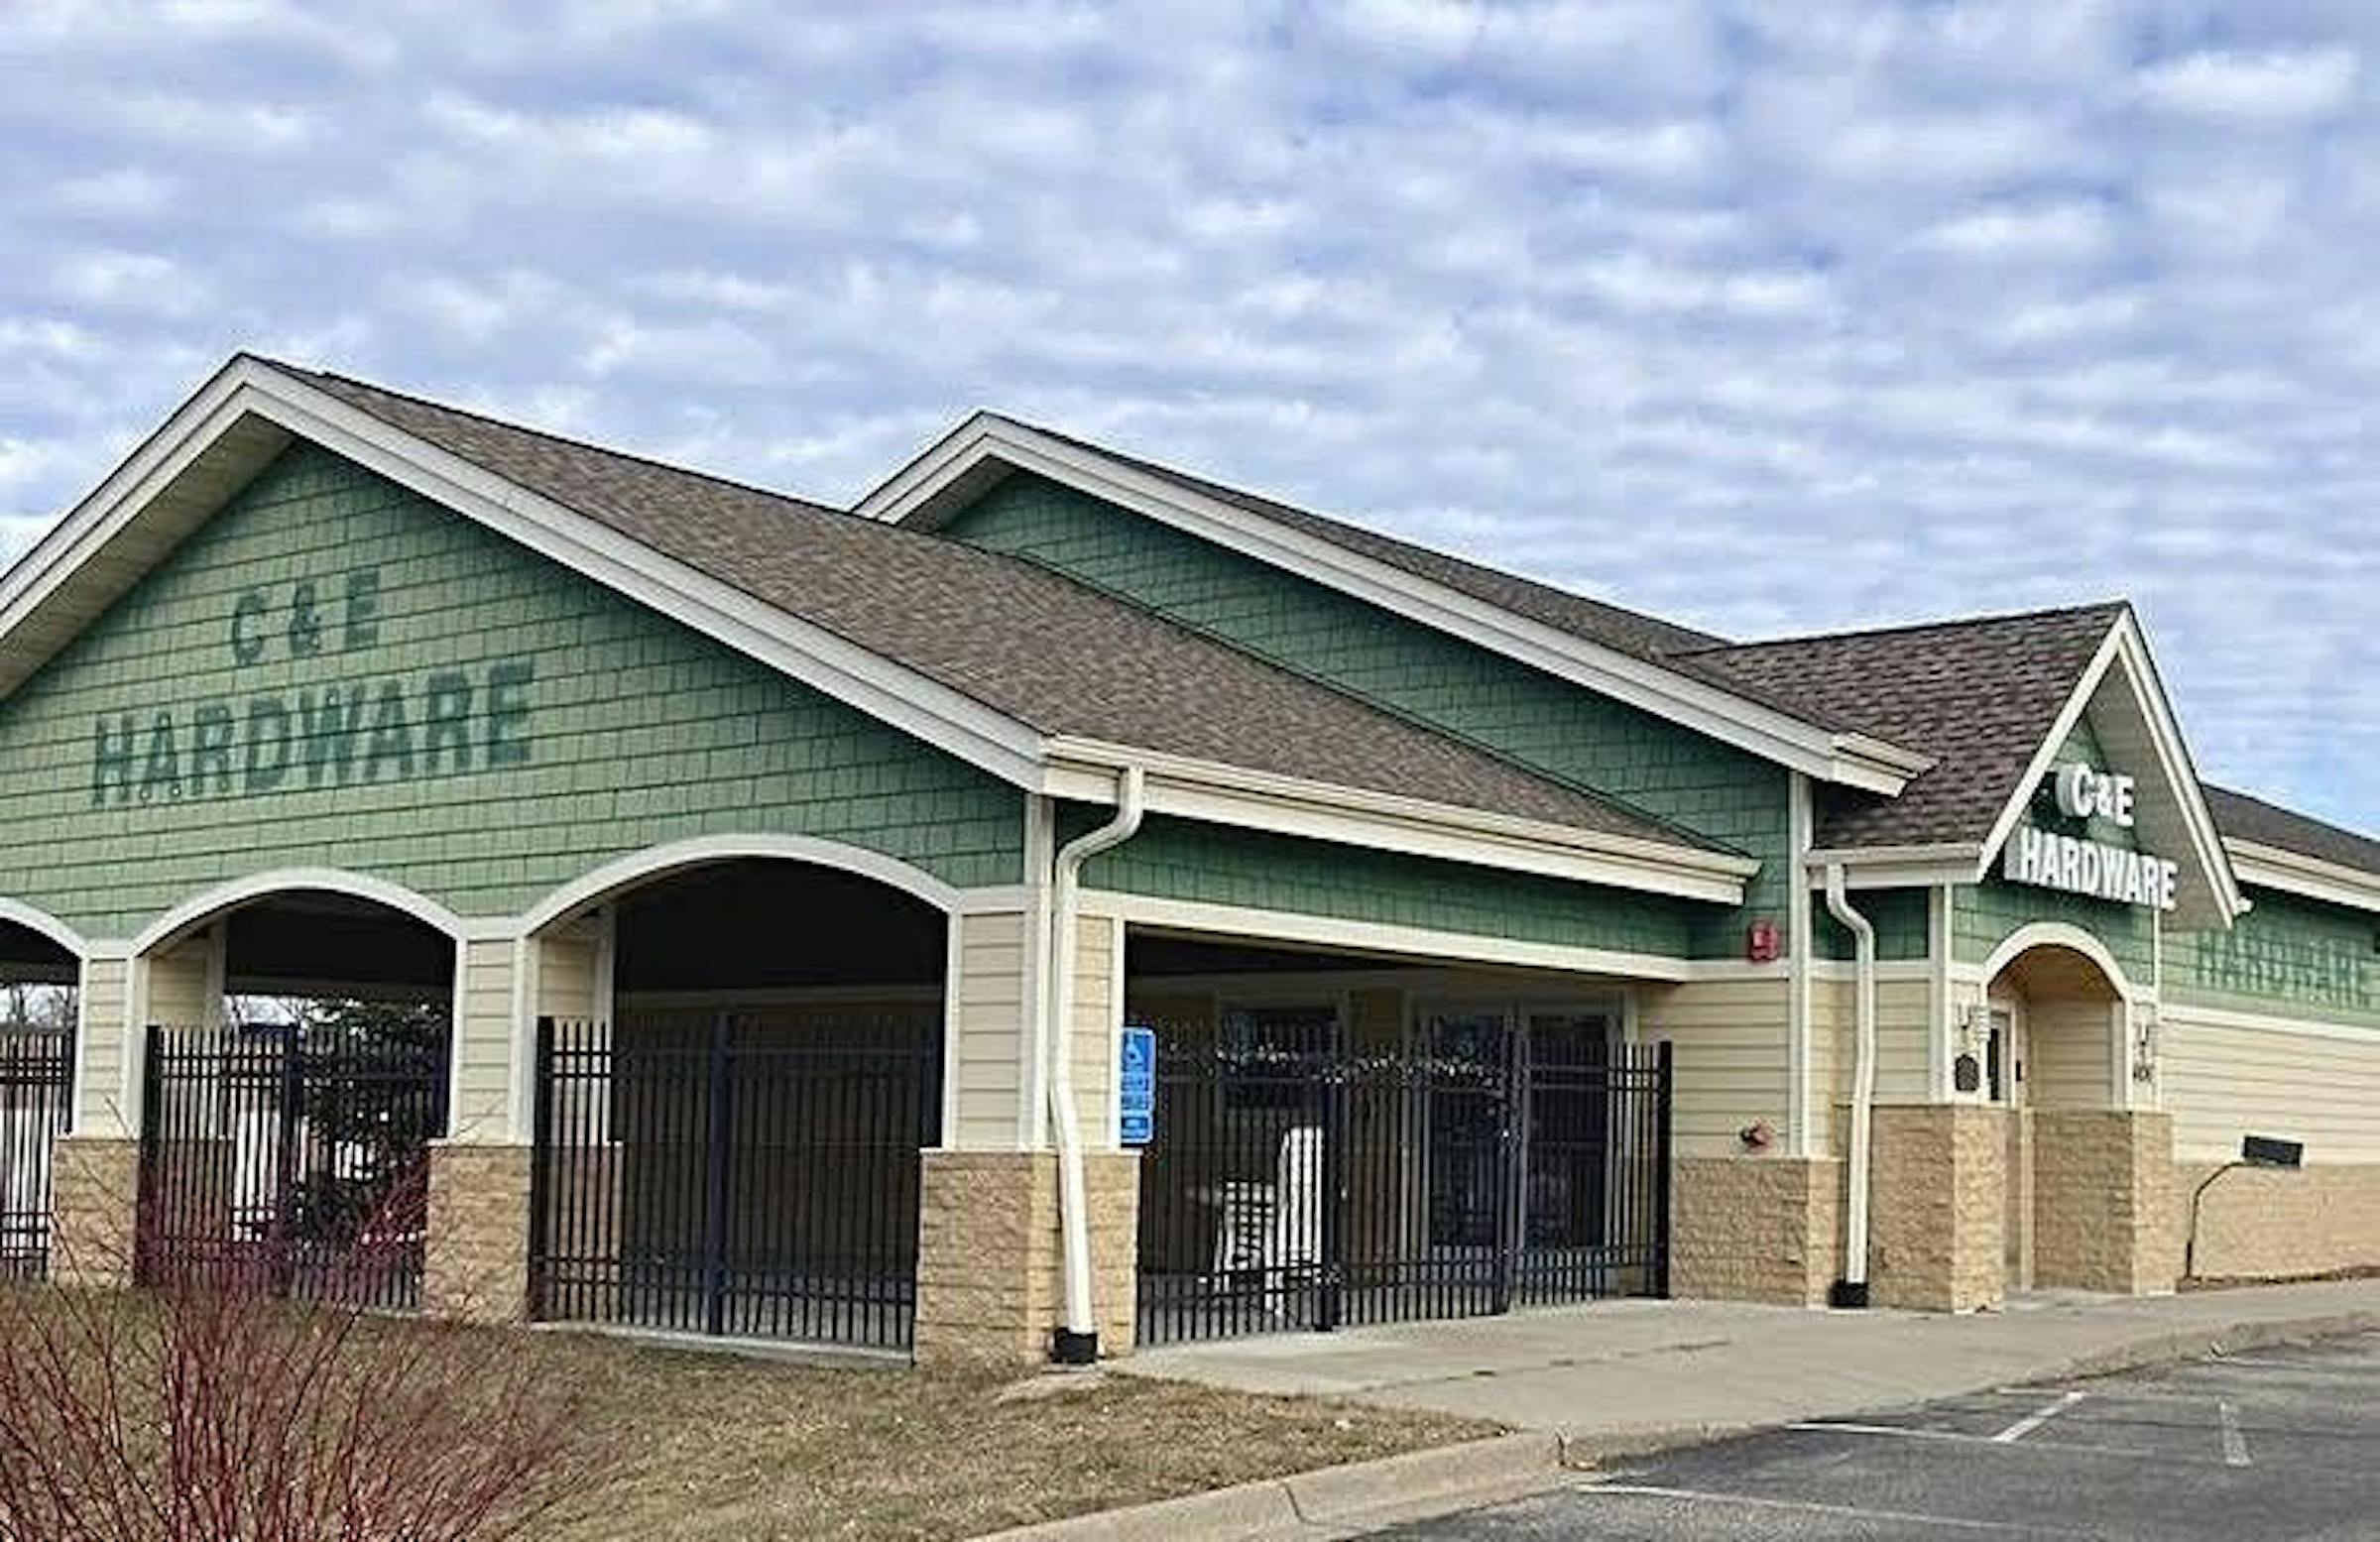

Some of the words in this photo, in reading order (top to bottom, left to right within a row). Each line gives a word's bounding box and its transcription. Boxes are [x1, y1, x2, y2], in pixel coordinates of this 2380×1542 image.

[232, 592, 266, 667] C
[290, 582, 322, 658] &
[346, 569, 380, 650] E
[93, 661, 535, 805] HARDWARE
[2071, 763, 2135, 827] C&E
[2019, 825, 2179, 911] HARDWARE
